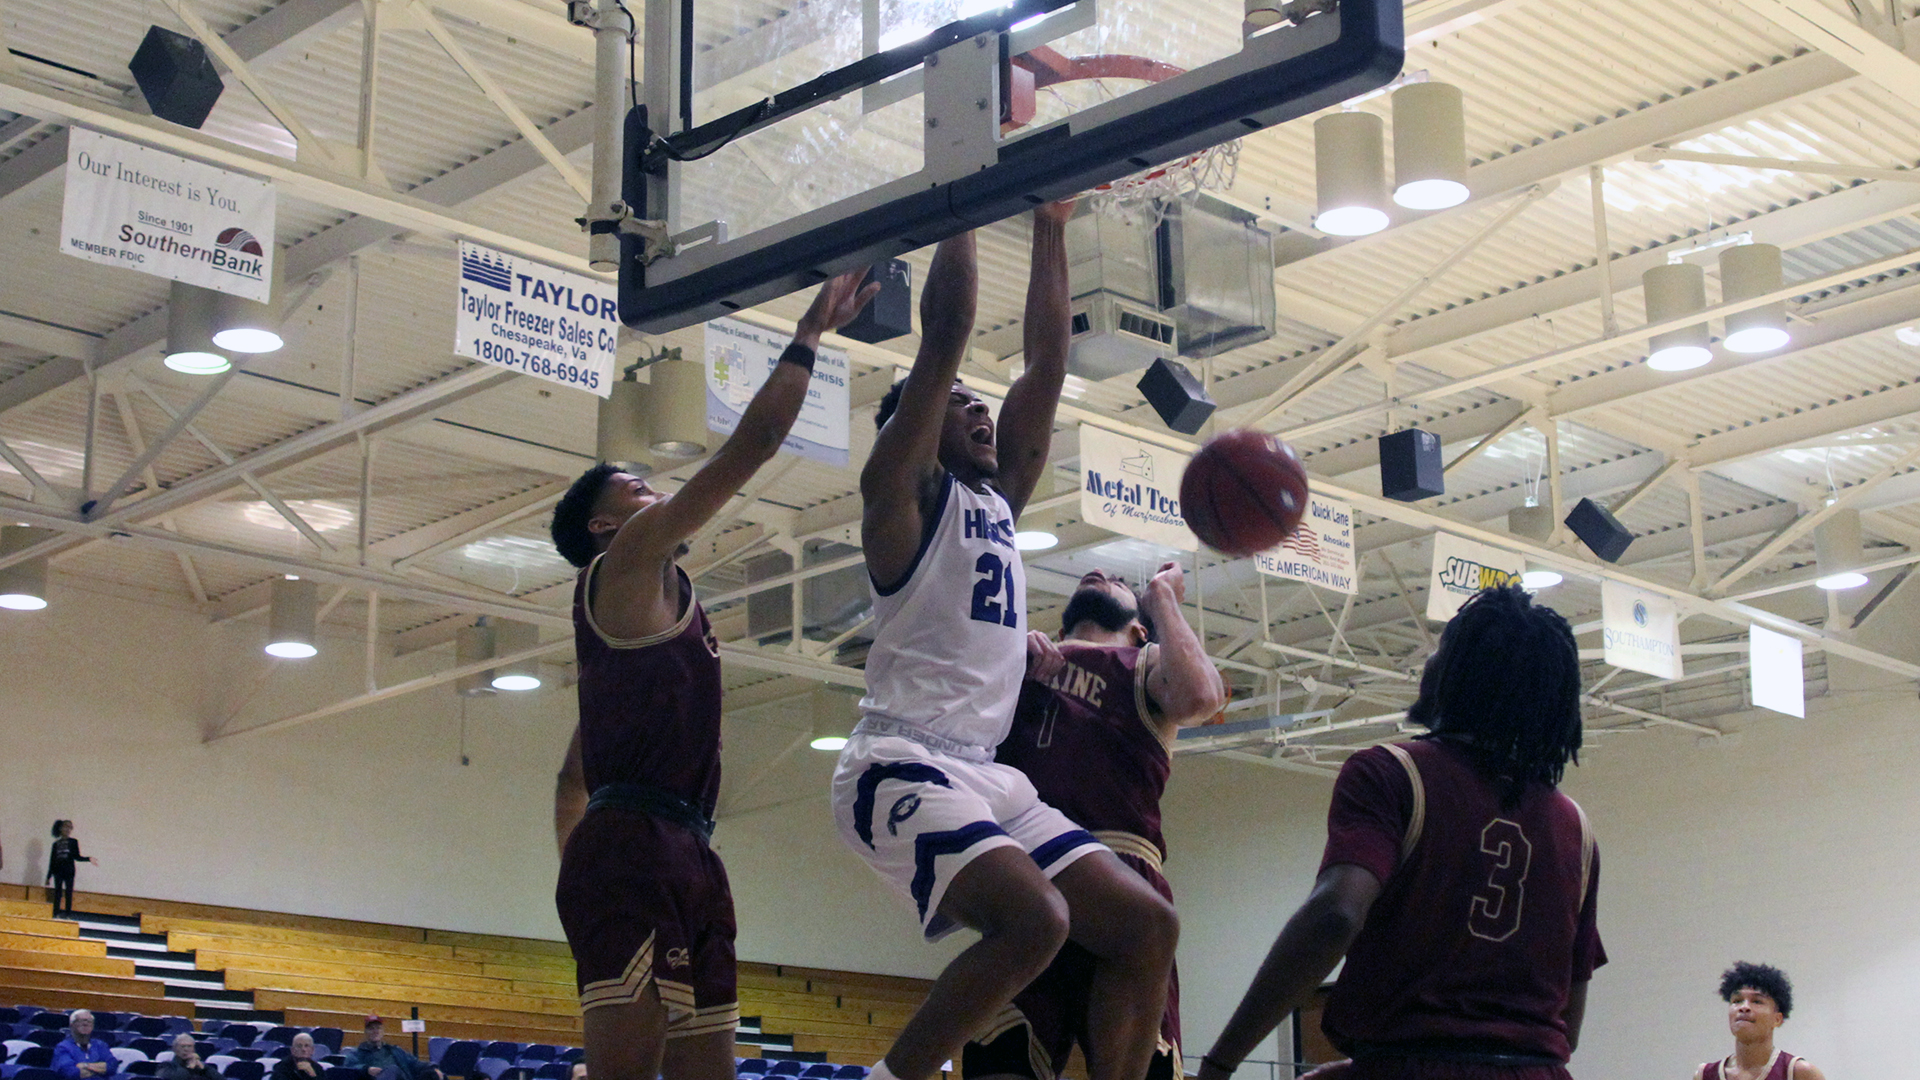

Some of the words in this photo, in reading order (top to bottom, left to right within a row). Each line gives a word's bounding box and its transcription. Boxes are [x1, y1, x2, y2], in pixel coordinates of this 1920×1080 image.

[78, 151, 111, 177] Our
[117, 161, 182, 197] Interest
[188, 182, 201, 201] is
[206, 187, 241, 214] You.
[138, 210, 167, 227] Since
[171, 220, 193, 234] 1901
[71, 238, 117, 258] MEMBER
[119, 250, 145, 264] FDIC
[118, 224, 264, 277] SouthernBank
[516, 273, 617, 323] TAYLOR
[461, 287, 501, 322] Taylor
[505, 301, 555, 336] Freezer
[558, 316, 594, 348] Sales
[491, 323, 567, 358] Chesapeake,
[571, 345, 587, 361] Va
[473, 338, 600, 389] 1800-768-6945
[811, 369, 845, 387] CRISIS
[1086, 469, 1141, 506] Metal
[1146, 486, 1184, 519] Tec
[1312, 500, 1331, 521] Quick
[1332, 507, 1349, 526] Lane
[1103, 502, 1118, 518] Of
[1121, 504, 1185, 527] Murfreesboro
[1341, 529, 1349, 537] of
[1323, 534, 1351, 549] Ahoskie
[970, 551, 1018, 629] 21
[1256, 553, 1275, 572] THE
[1277, 561, 1329, 585] AMERICAN
[1331, 573, 1351, 590] WAY
[1468, 817, 1533, 942] 3
